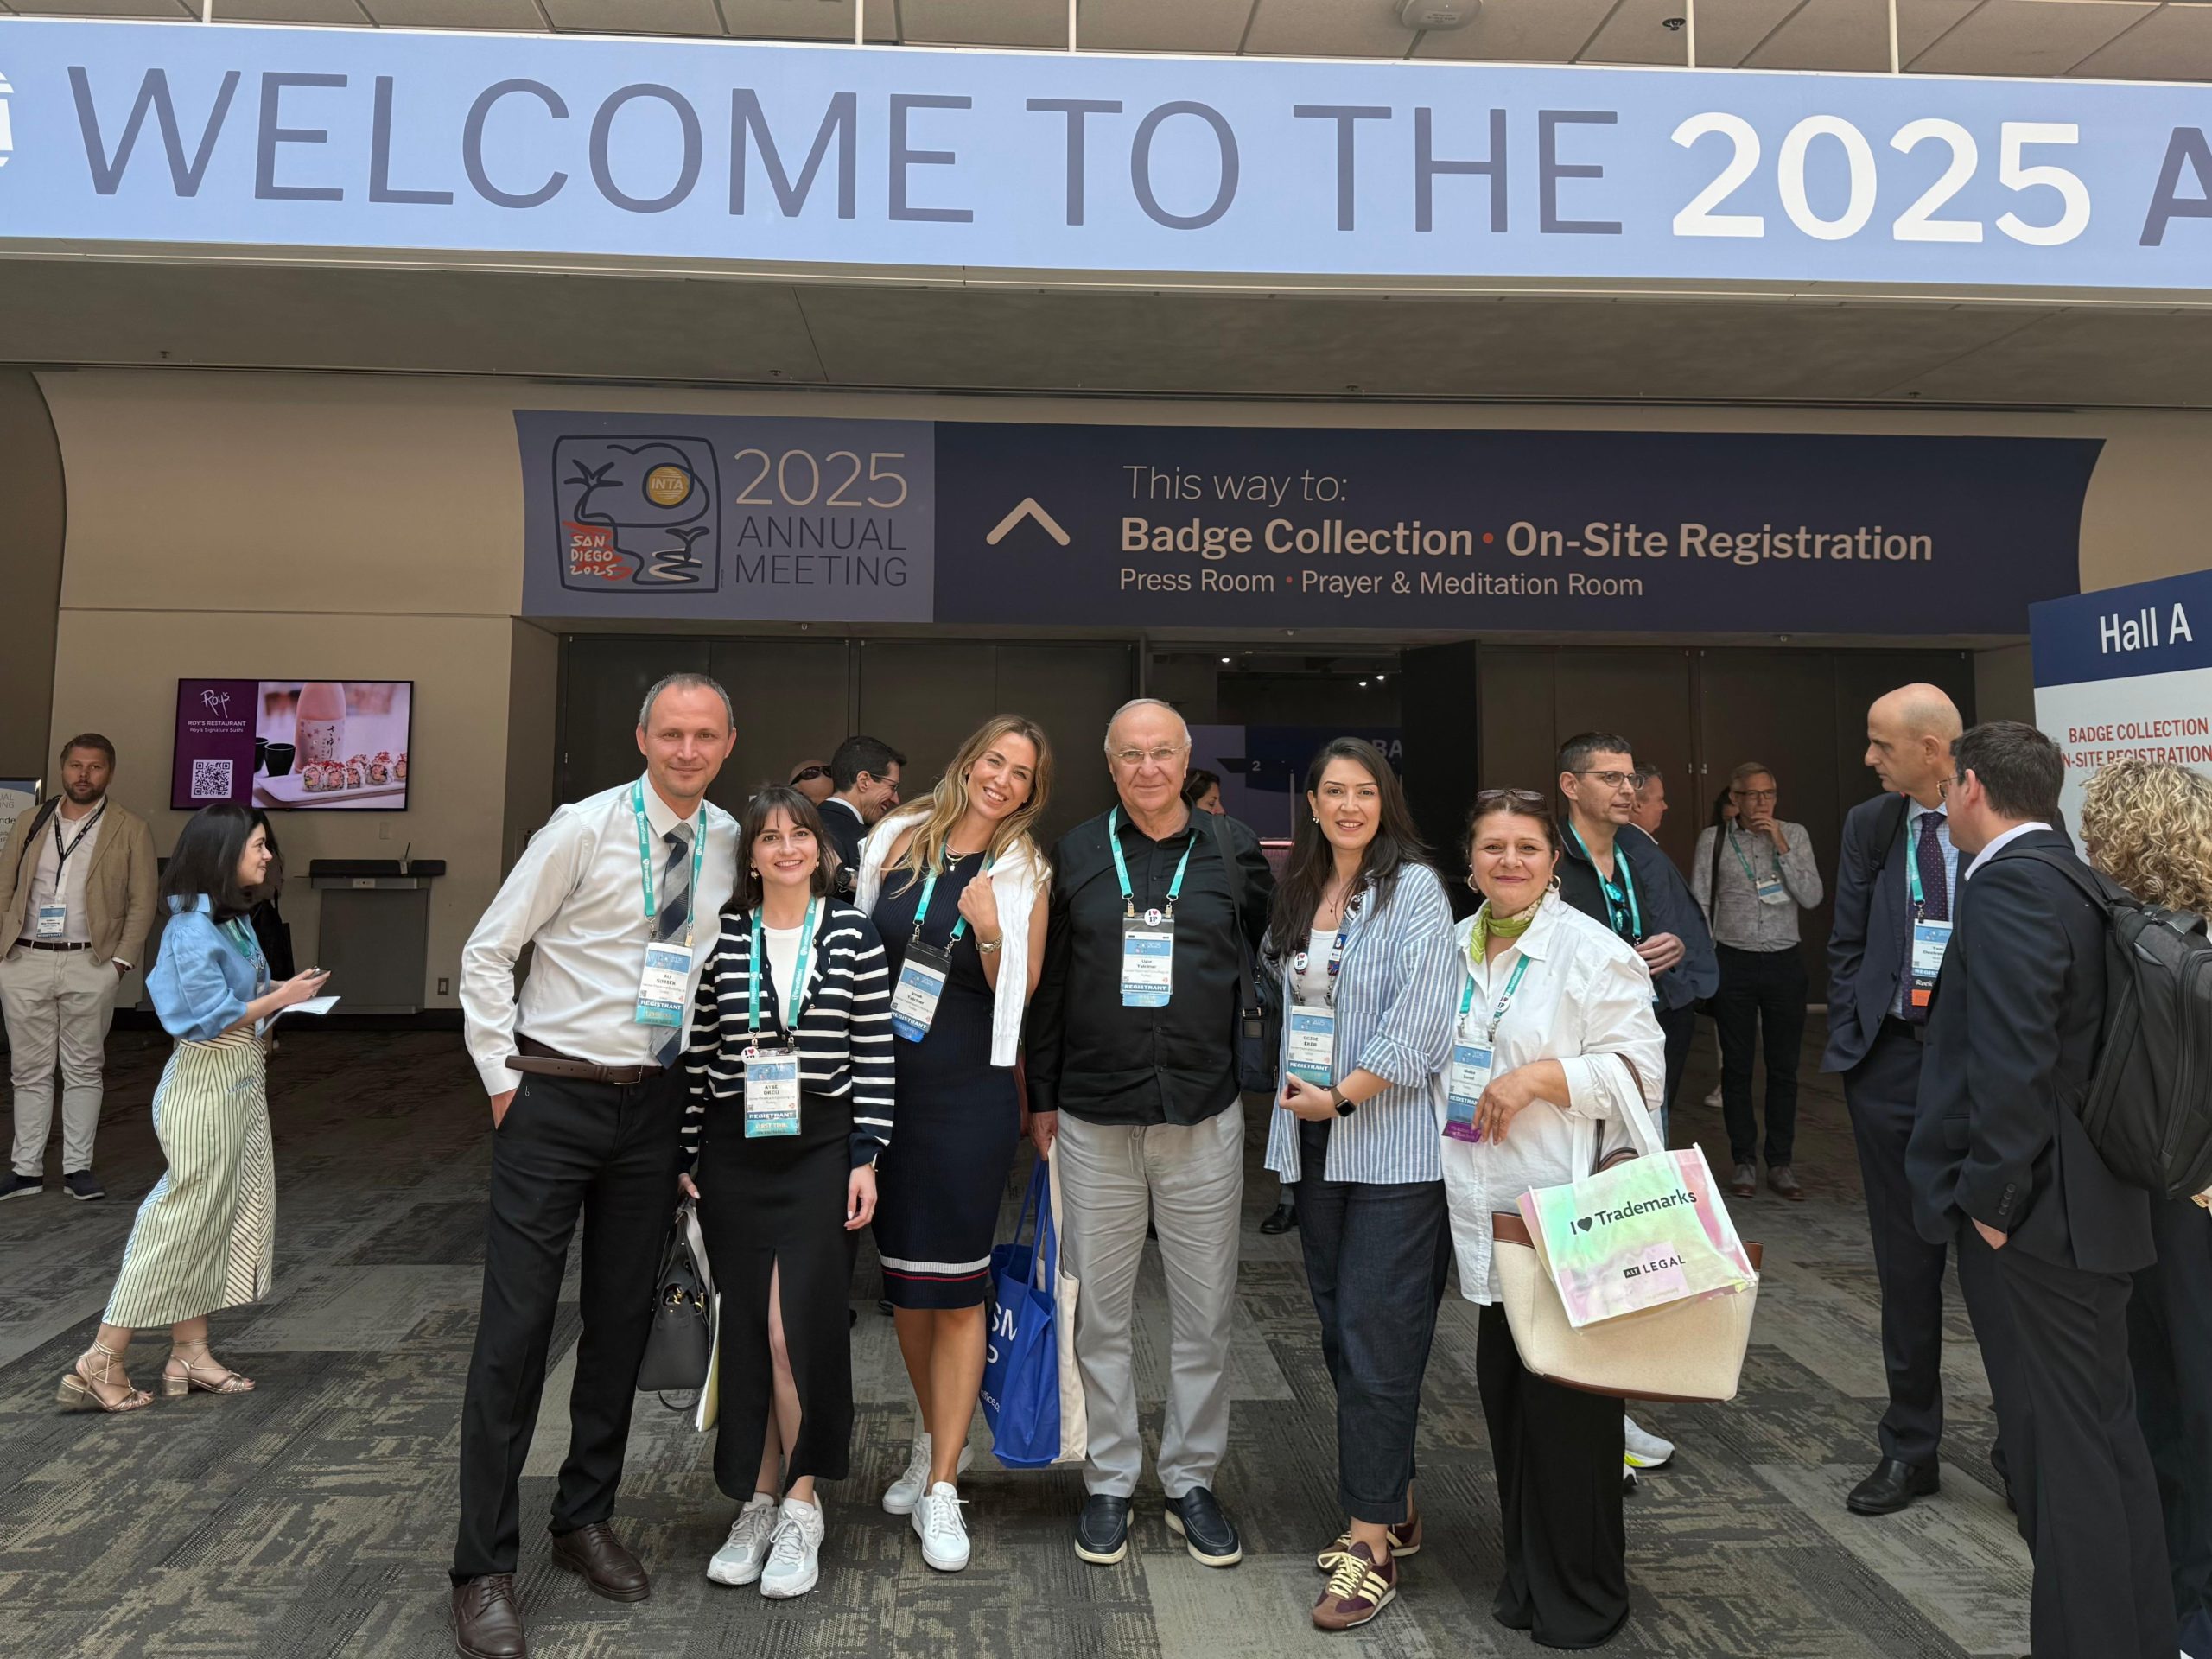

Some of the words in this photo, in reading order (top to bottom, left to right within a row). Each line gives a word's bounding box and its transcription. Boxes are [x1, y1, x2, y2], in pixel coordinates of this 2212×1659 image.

[67, 66, 974, 223] WELCOME
[1026, 99, 1240, 231] TO
[1293, 105, 1623, 235] THE
[1669, 111, 2092, 247] 2025
[651, 477, 684, 490] INTA
[734, 448, 908, 509] 2025
[1122, 465, 1202, 500] This
[1213, 474, 1291, 508] way
[1300, 469, 1348, 502] to:
[571, 535, 605, 547] SAN
[736, 516, 907, 550] ANNUAL
[1121, 517, 1253, 560] Badge
[1264, 518, 1473, 556] Collection
[1506, 521, 1668, 558] On-Site
[1679, 523, 1933, 566] Registration
[571, 548, 613, 562] DIEGO
[569, 564, 618, 576] 2025
[735, 553, 907, 587] MEETING
[1120, 568, 1192, 591] Press
[1201, 569, 1274, 592] Room
[1301, 570, 1383, 598] Prayer
[1390, 572, 1411, 594] &
[1420, 571, 1558, 595] Meditation
[1568, 573, 1643, 595] Room
[2100, 607, 2158, 654] Hall
[2169, 602, 2193, 645] A
[200, 690, 231, 718] Roy's
[2069, 724, 2114, 744] BADGE
[2117, 717, 2209, 741] COLLECTION
[2062, 750, 2103, 767] N-SITE
[640, 1000, 683, 1010] REGISTRANT
[892, 1012, 927, 1029] REGISTRANT
[1289, 1062, 1329, 1071] REGISTRANT
[1449, 1095, 1478, 1105] REGISTRAN
[1570, 1221, 1577, 1235] I
[1594, 1189, 1697, 1226] Trademarks
[1625, 1268, 1639, 1277] ALT
[1643, 1255, 1686, 1274] LEGAL
